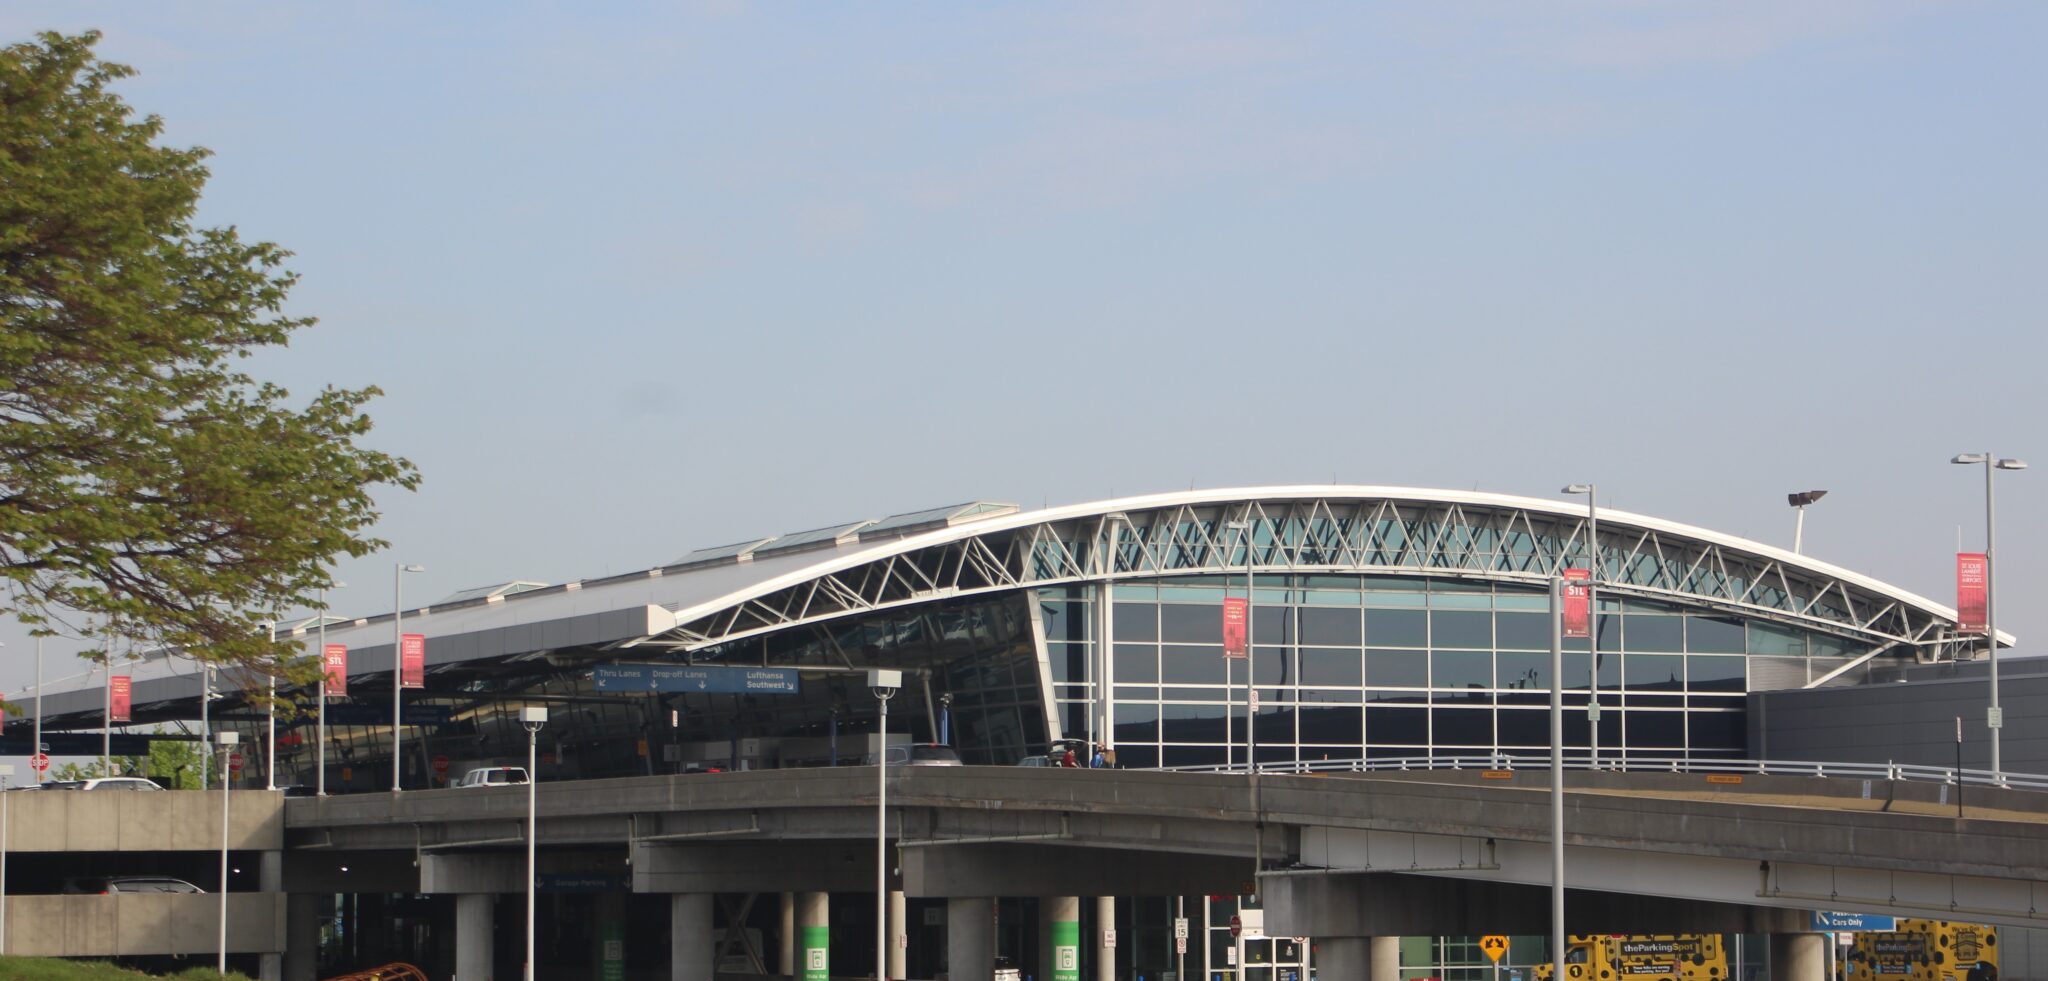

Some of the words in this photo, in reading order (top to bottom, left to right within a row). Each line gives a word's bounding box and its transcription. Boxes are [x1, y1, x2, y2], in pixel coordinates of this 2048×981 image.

[329, 657, 343, 665] STL
[653, 671, 682, 680] Drop-off
[1848, 919, 1862, 927] Only
[1624, 943, 1694, 952] theParkingSpot
[1572, 967, 1578, 976] 1
